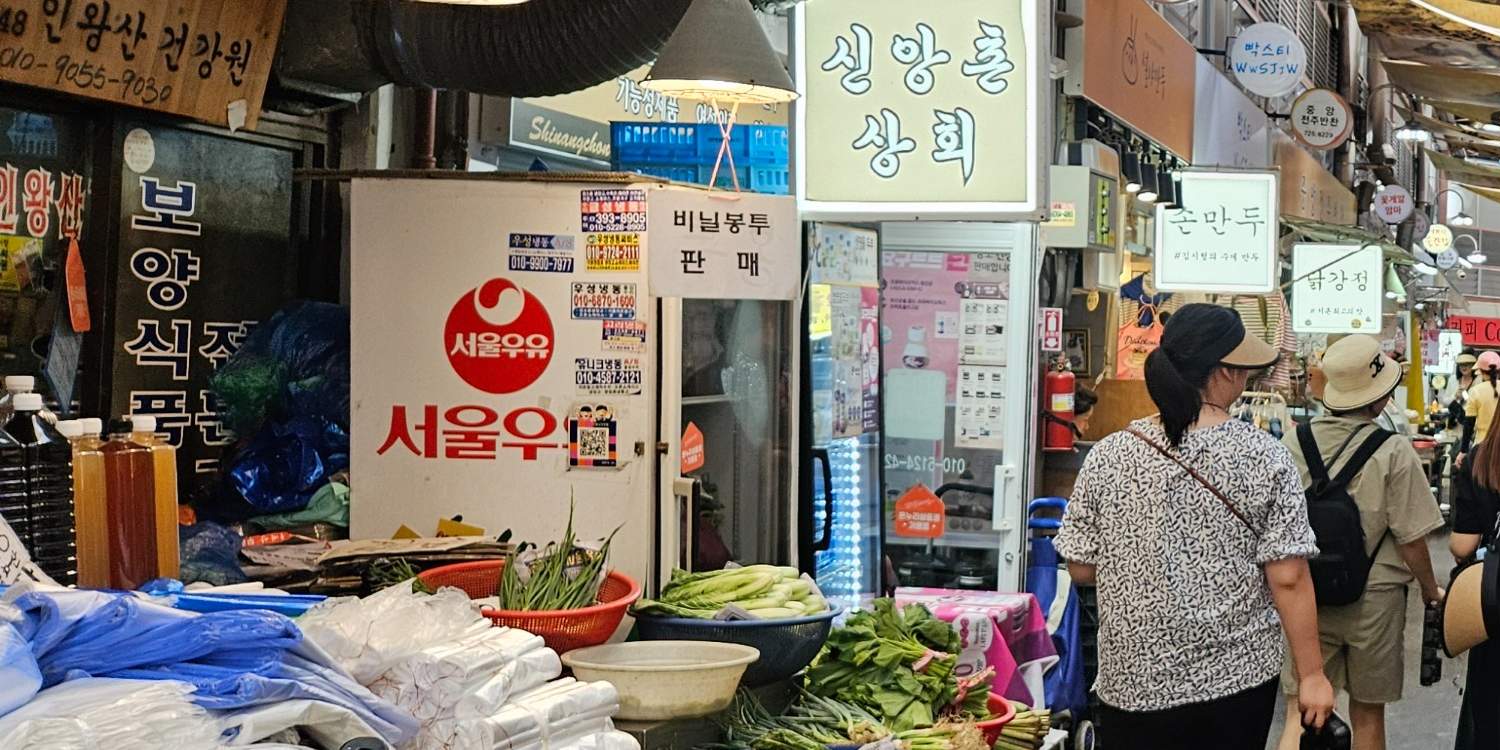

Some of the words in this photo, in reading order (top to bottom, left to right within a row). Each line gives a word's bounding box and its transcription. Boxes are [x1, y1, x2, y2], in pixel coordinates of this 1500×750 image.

[43, 0, 148, 60] 인왕산
[160, 23, 252, 86] 건강원
[821, 20, 1015, 95] 신앙촌
[0, 47, 172, 103] 010-9055-9030
[852, 107, 975, 187] 상회
[674, 210, 770, 235] 비닐봉투
[1168, 205, 1265, 236] 손만두
[511, 256, 572, 271] 010-9900-7977
[452, 332, 550, 359] 서울우유
[577, 371, 640, 384] 010-4587-2121
[377, 405, 570, 460] 서울우
